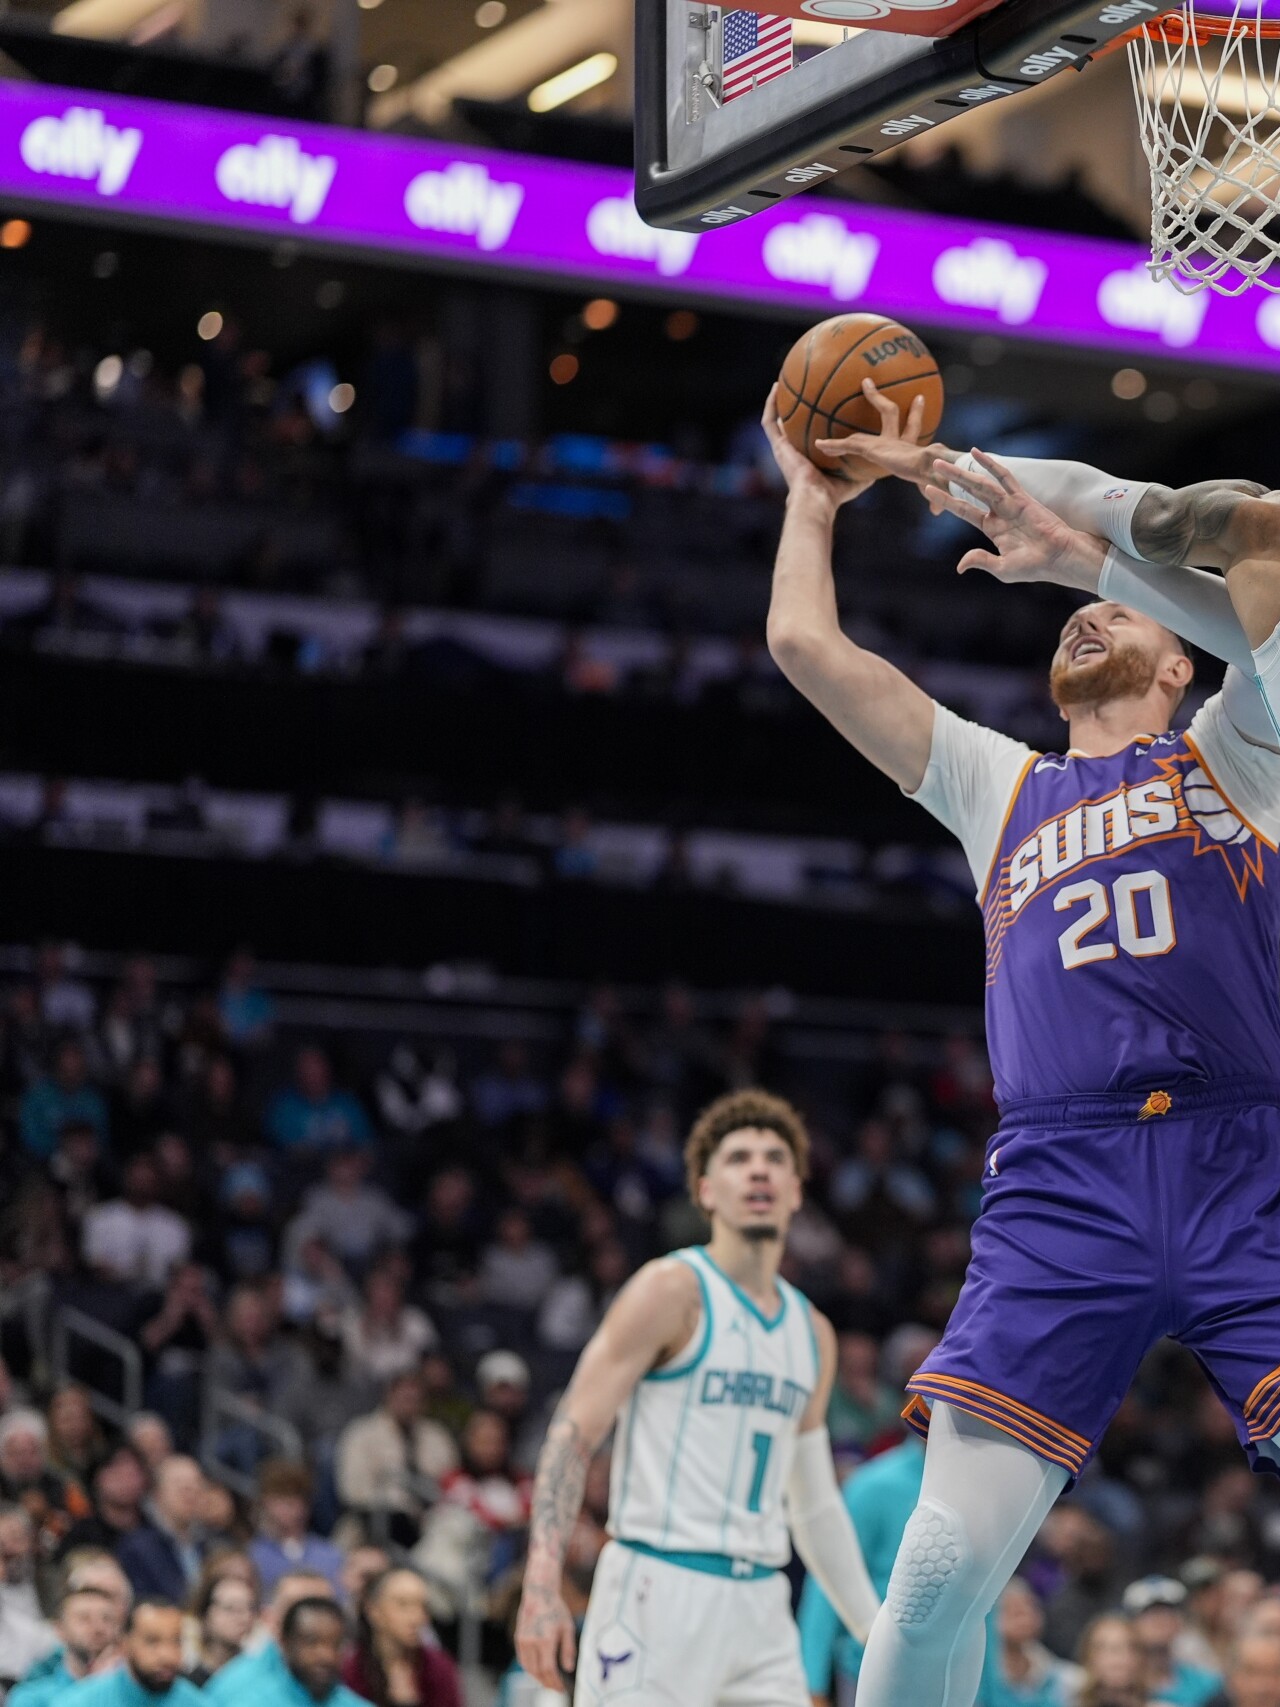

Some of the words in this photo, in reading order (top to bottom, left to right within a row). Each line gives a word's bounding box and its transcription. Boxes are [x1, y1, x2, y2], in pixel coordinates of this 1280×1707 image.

[701, 205, 752, 224] ally
[785, 162, 838, 183] ally
[880, 114, 935, 136] ally
[959, 85, 1013, 100] ally
[1020, 46, 1078, 75] ally
[1099, 0, 1158, 23] ally
[21, 107, 141, 194] ally
[216, 135, 335, 222] ally
[405, 163, 522, 249] ally
[763, 214, 879, 298] ally
[933, 239, 1047, 323] ally
[1053, 870, 1176, 970] 20
[747, 1431, 772, 1512] 1
